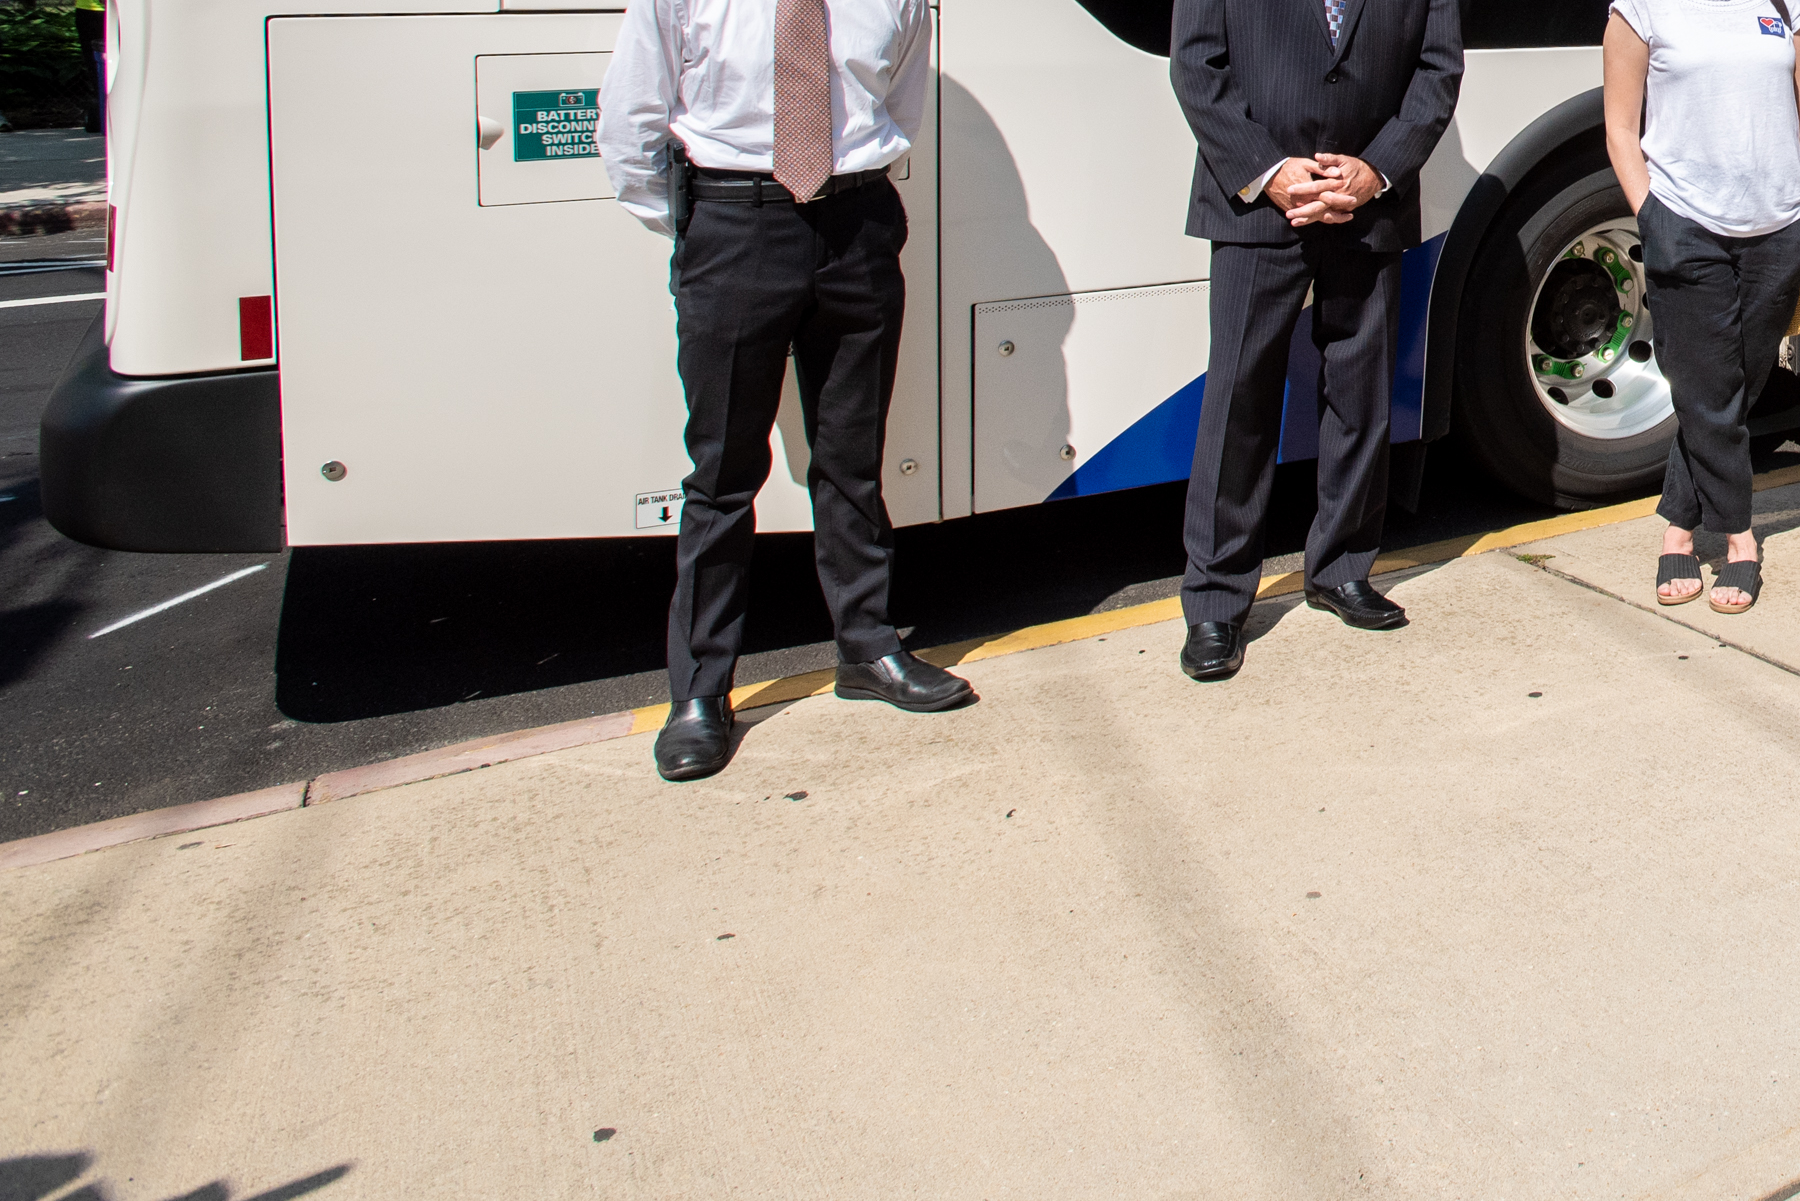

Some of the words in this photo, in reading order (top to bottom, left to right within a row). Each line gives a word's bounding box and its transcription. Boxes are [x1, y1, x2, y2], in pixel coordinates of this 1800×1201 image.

[519, 120, 600, 134] DISCONN
[546, 144, 600, 156] INSIDE
[638, 497, 650, 506] AIR
[651, 495, 668, 504] TANK
[669, 493, 686, 502] DRAI
